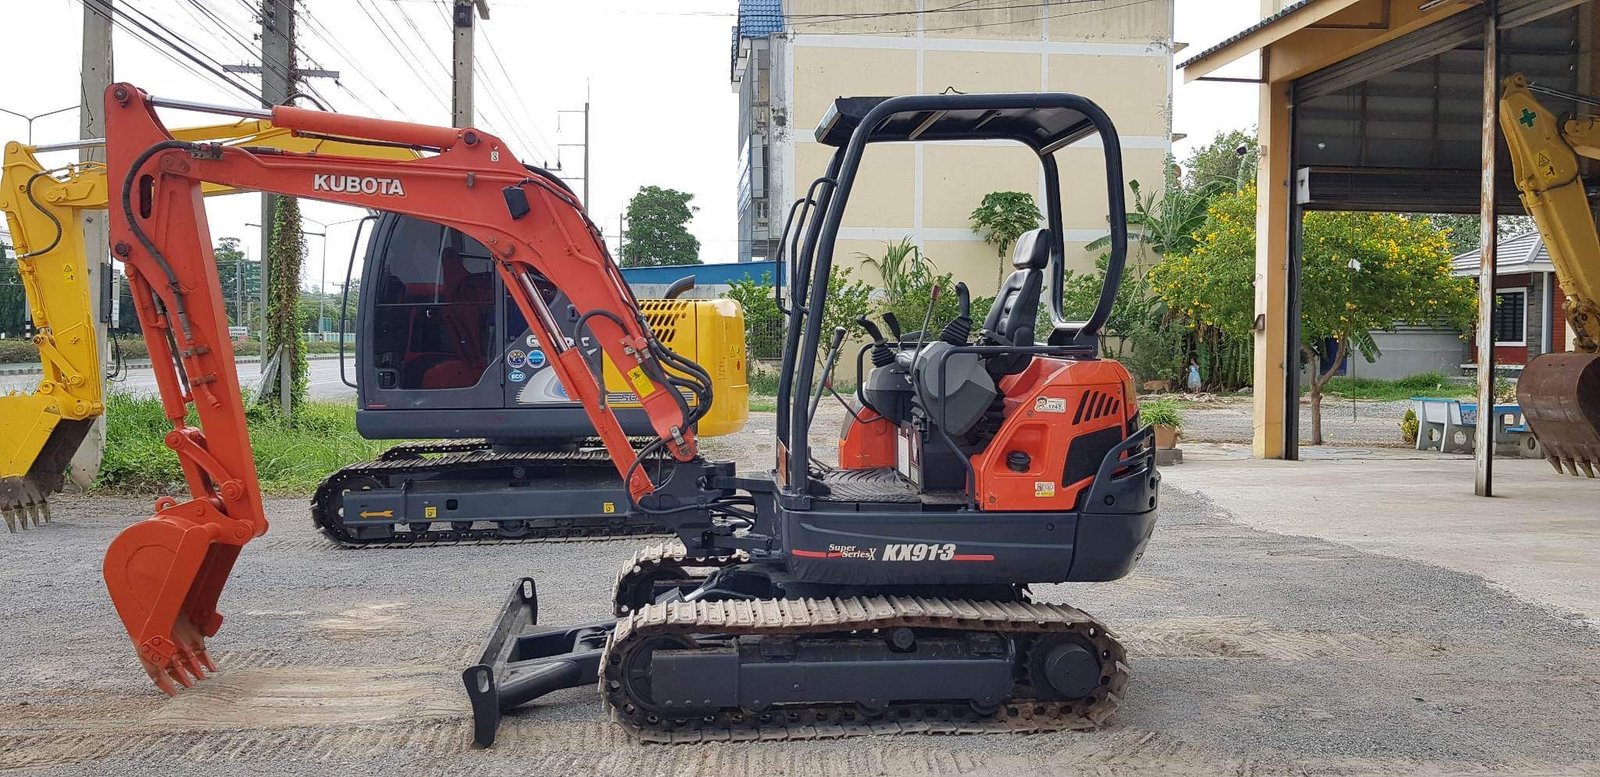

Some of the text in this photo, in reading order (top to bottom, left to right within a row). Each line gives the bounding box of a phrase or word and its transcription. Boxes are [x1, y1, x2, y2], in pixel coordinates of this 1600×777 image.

[313, 173, 404, 196] KUBOTA
[828, 543, 856, 553] Super
[882, 543, 956, 562] KX91-3
